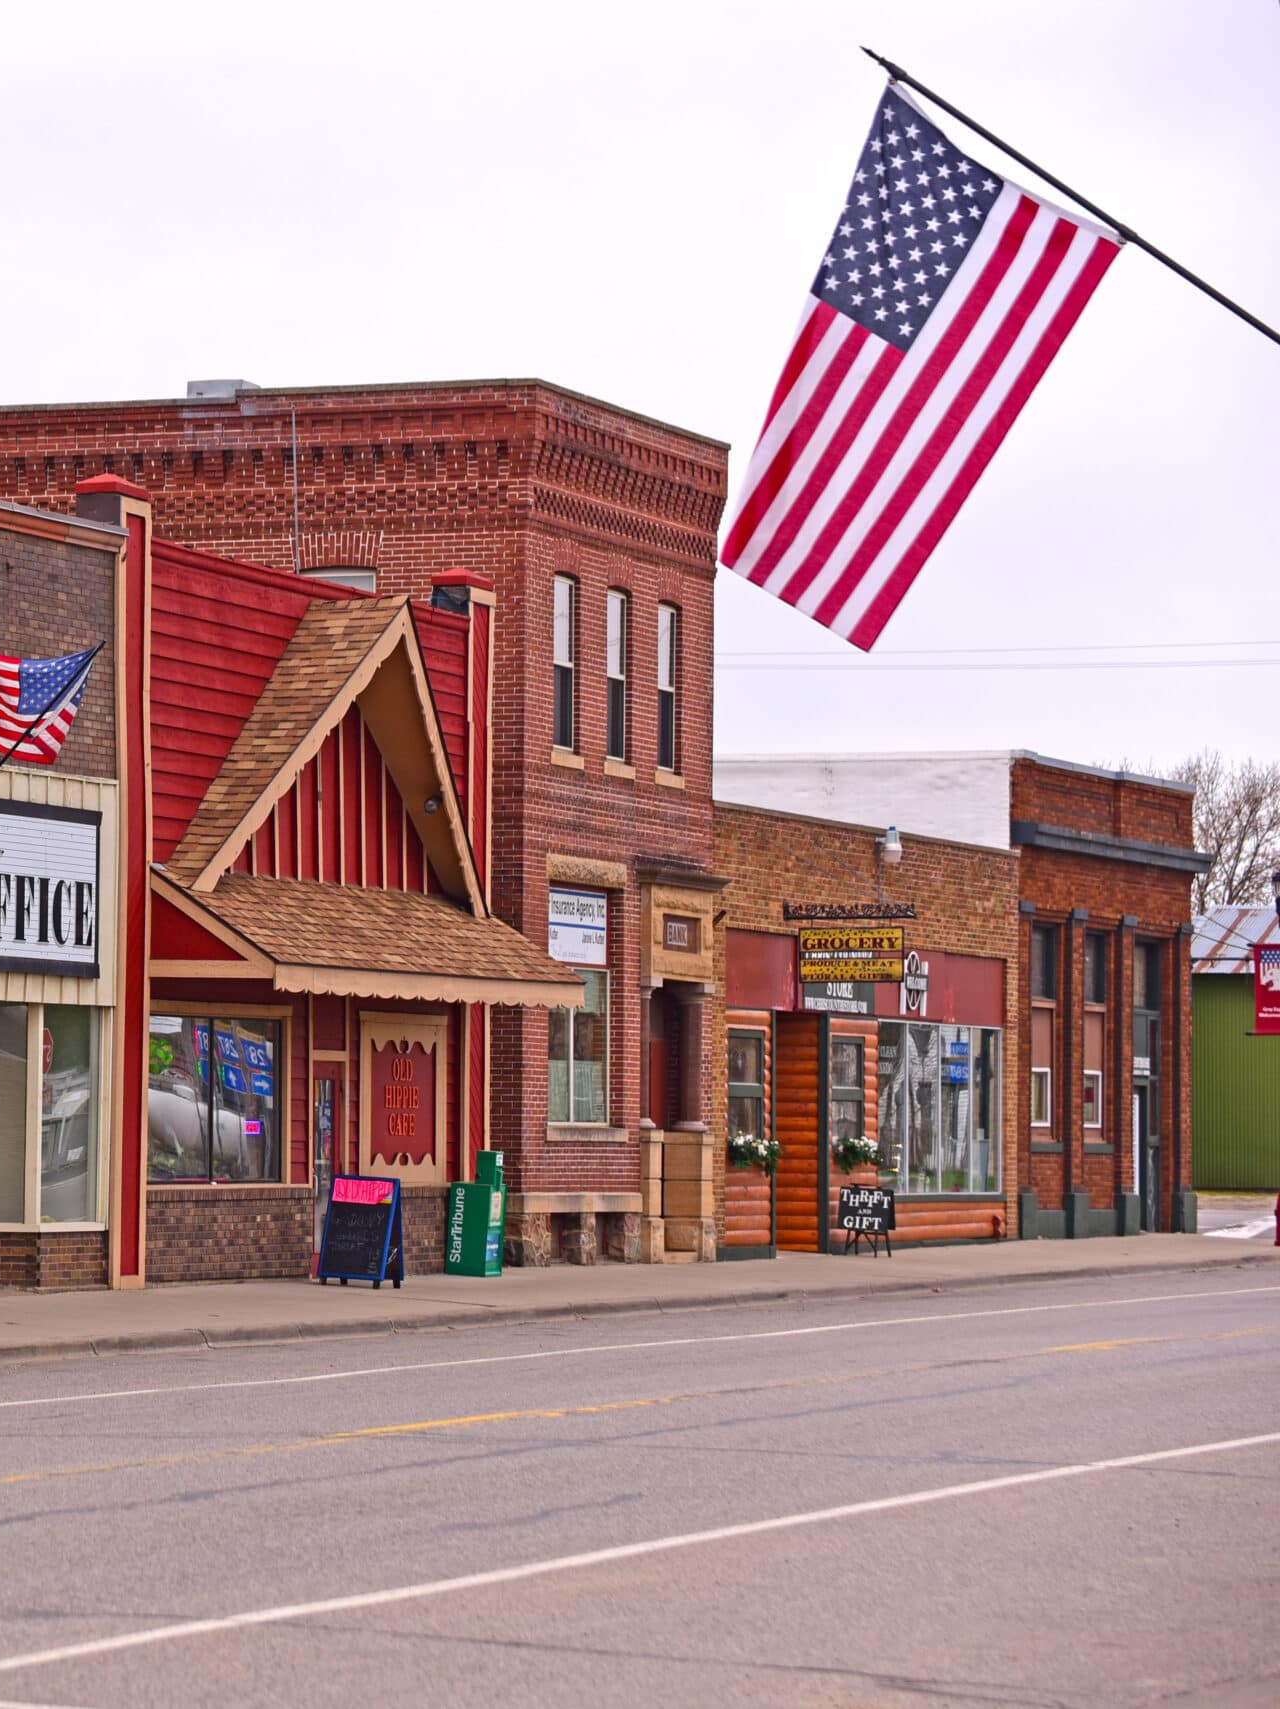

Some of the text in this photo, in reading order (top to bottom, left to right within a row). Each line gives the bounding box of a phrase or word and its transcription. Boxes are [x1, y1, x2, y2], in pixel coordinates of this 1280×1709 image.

[551, 896, 576, 916] Insurance
[667, 922, 688, 946] BANK
[802, 936, 900, 951] GROCERY
[803, 959, 852, 968] PRODUCE
[862, 960, 895, 968] MEAT
[803, 973, 846, 981] FLORAL
[826, 982, 854, 999] STORE
[393, 1058, 414, 1081] OLD
[385, 1085, 420, 1109] HIPPIE
[388, 1112, 416, 1136] CAFE
[841, 1188, 891, 1209] THRIFT
[857, 1208, 872, 1216] AND
[449, 1187, 465, 1263] StarTribune
[843, 1215, 882, 1230] GIFT
